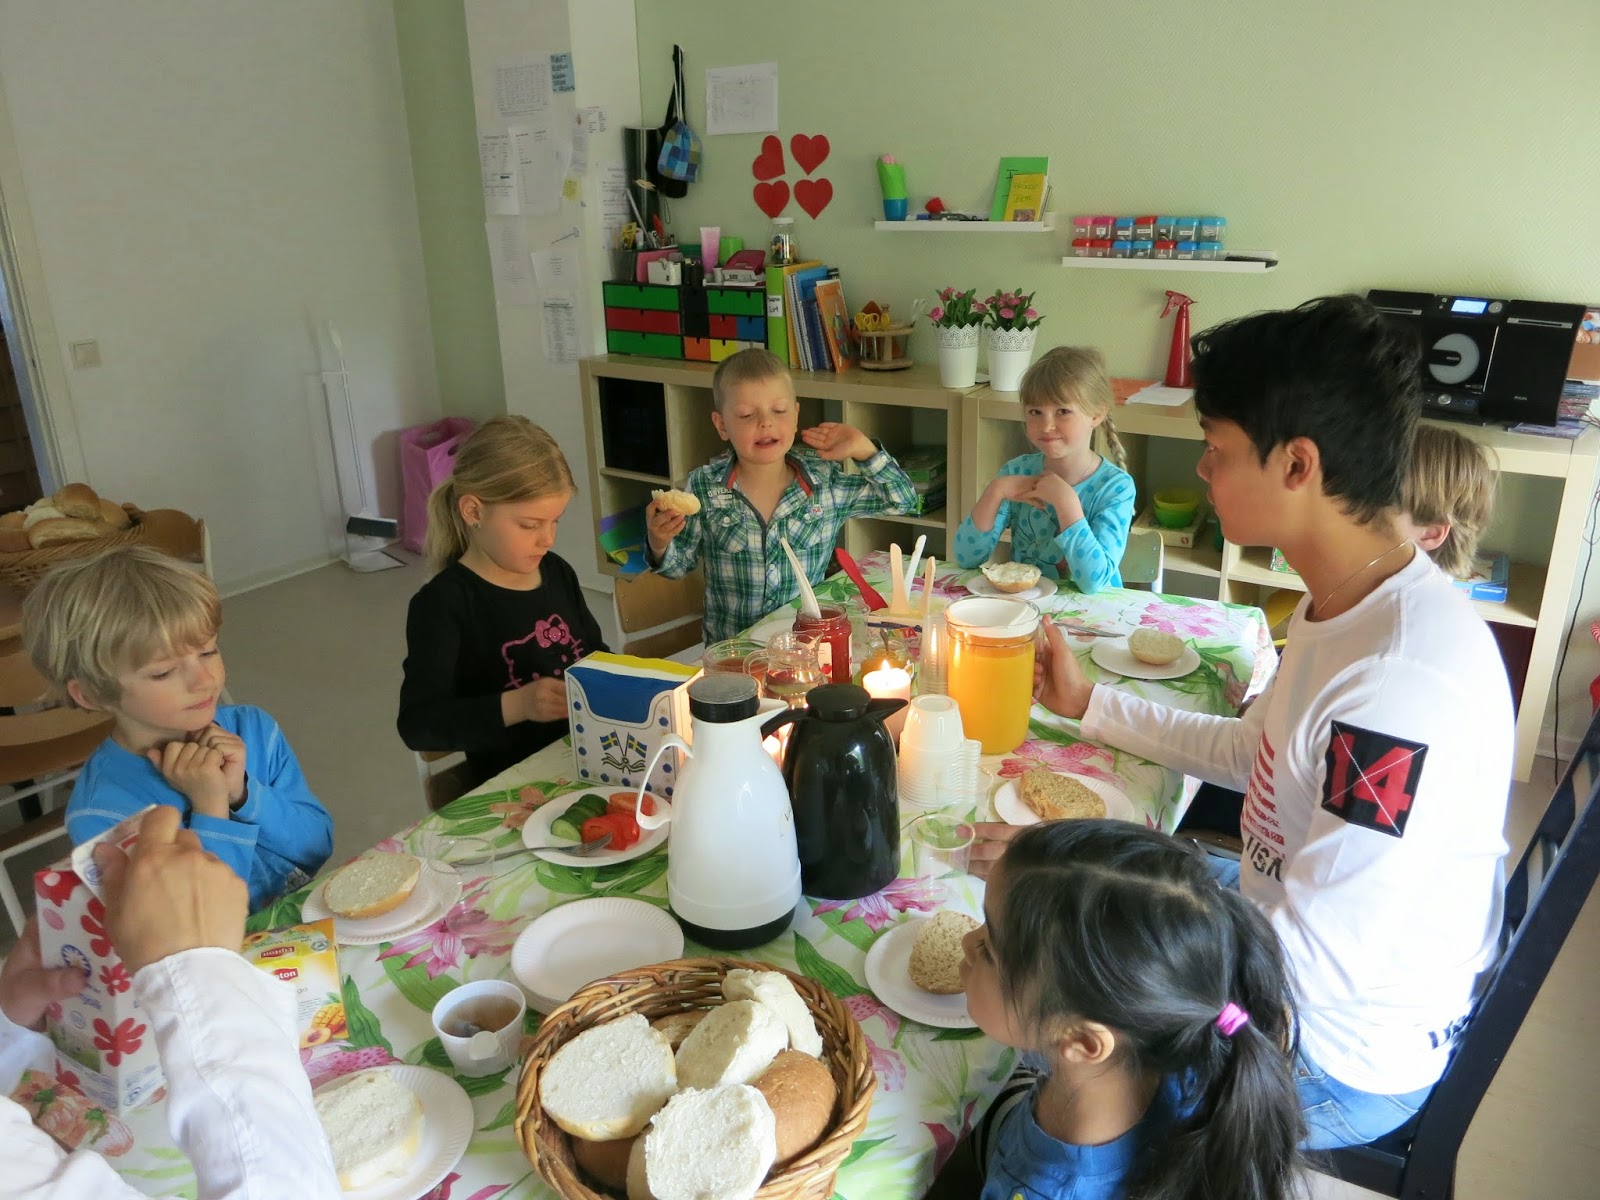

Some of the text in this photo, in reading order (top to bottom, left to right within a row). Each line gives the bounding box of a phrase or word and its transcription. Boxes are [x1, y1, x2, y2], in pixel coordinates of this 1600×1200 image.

[1331, 732, 1413, 827] 14
[1246, 836, 1283, 882] USA
[261, 946, 294, 958] Lipton
[277, 970, 297, 980] ton
